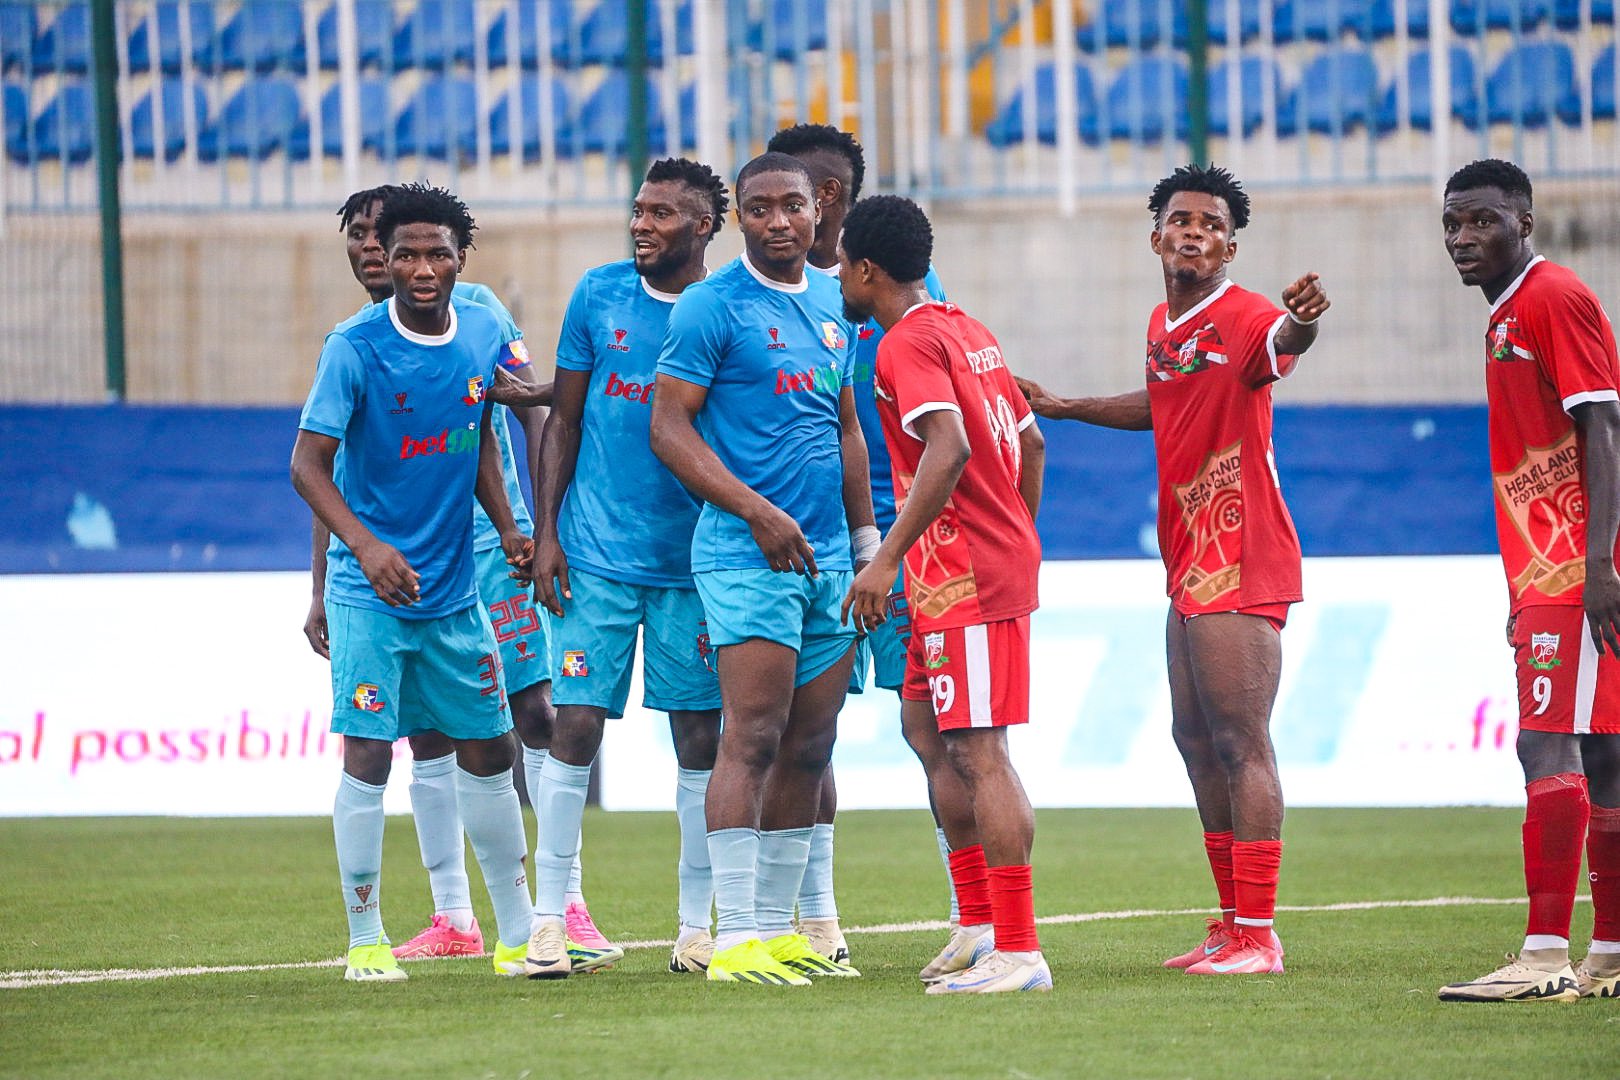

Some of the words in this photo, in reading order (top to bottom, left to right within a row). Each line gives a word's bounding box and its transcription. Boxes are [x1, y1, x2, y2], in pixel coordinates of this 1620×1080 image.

[489, 594, 540, 643] 25
[477, 651, 503, 696] 3
[1532, 675, 1553, 716] 9
[70, 707, 411, 776] possibili
